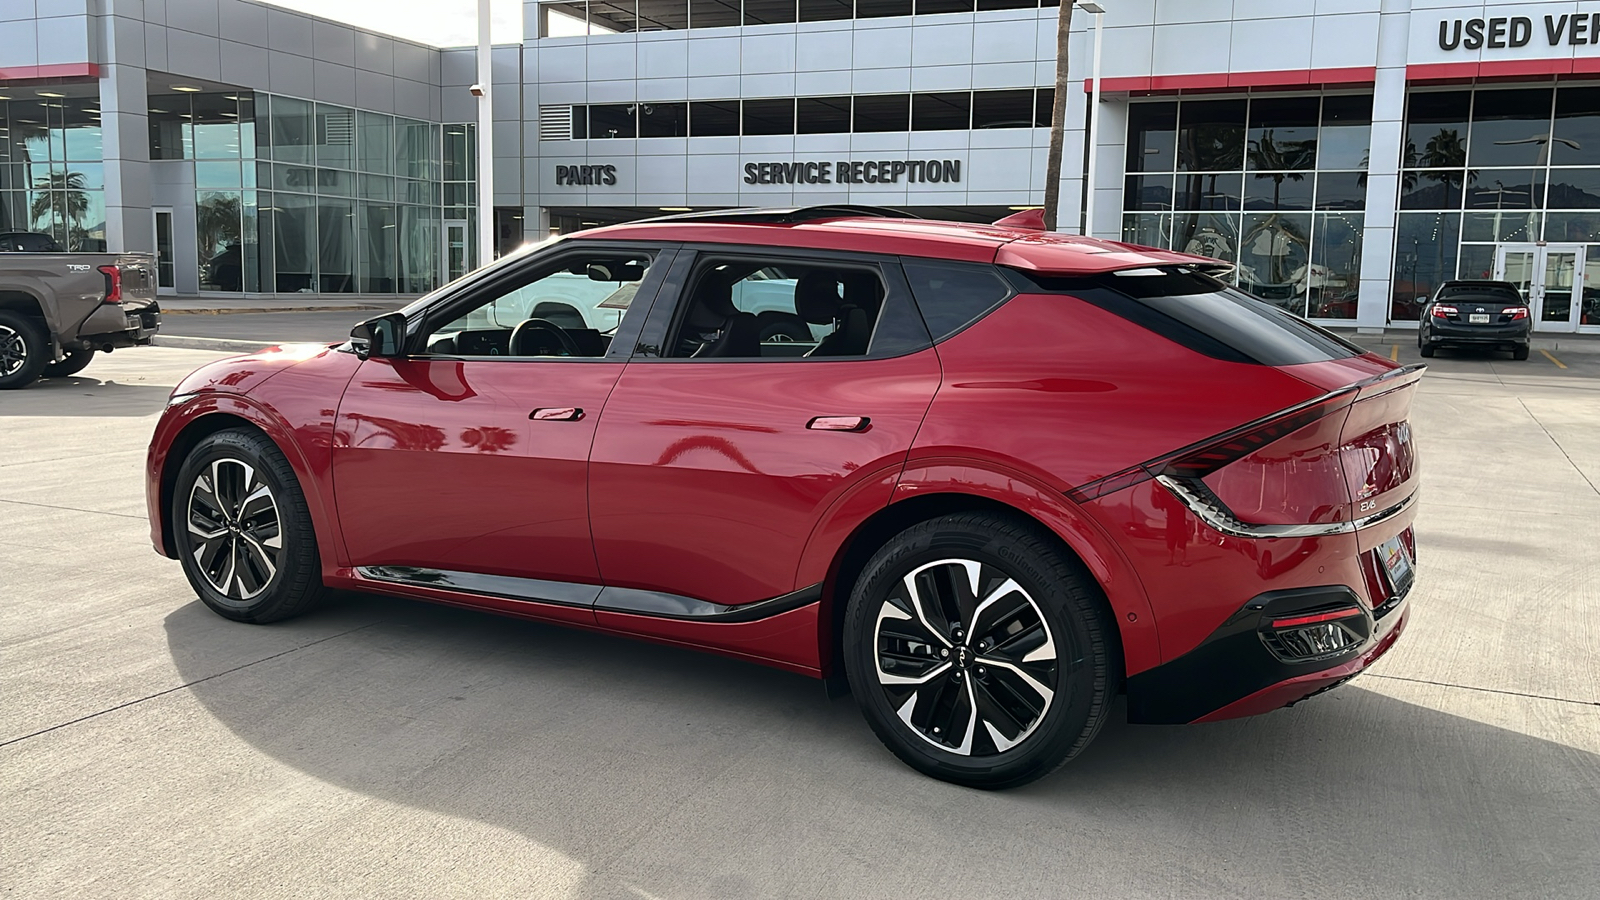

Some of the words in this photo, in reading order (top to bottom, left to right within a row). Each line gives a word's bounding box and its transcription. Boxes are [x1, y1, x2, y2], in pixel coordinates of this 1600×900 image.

[1439, 16, 1532, 51] USED
[556, 164, 617, 185] PARTS
[744, 162, 832, 184] SERVICE
[836, 160, 960, 184] RECEPTION
[1360, 499, 1376, 512] EV6
[998, 546, 1051, 590] Continental
[853, 542, 919, 630] CONTINENTAL
